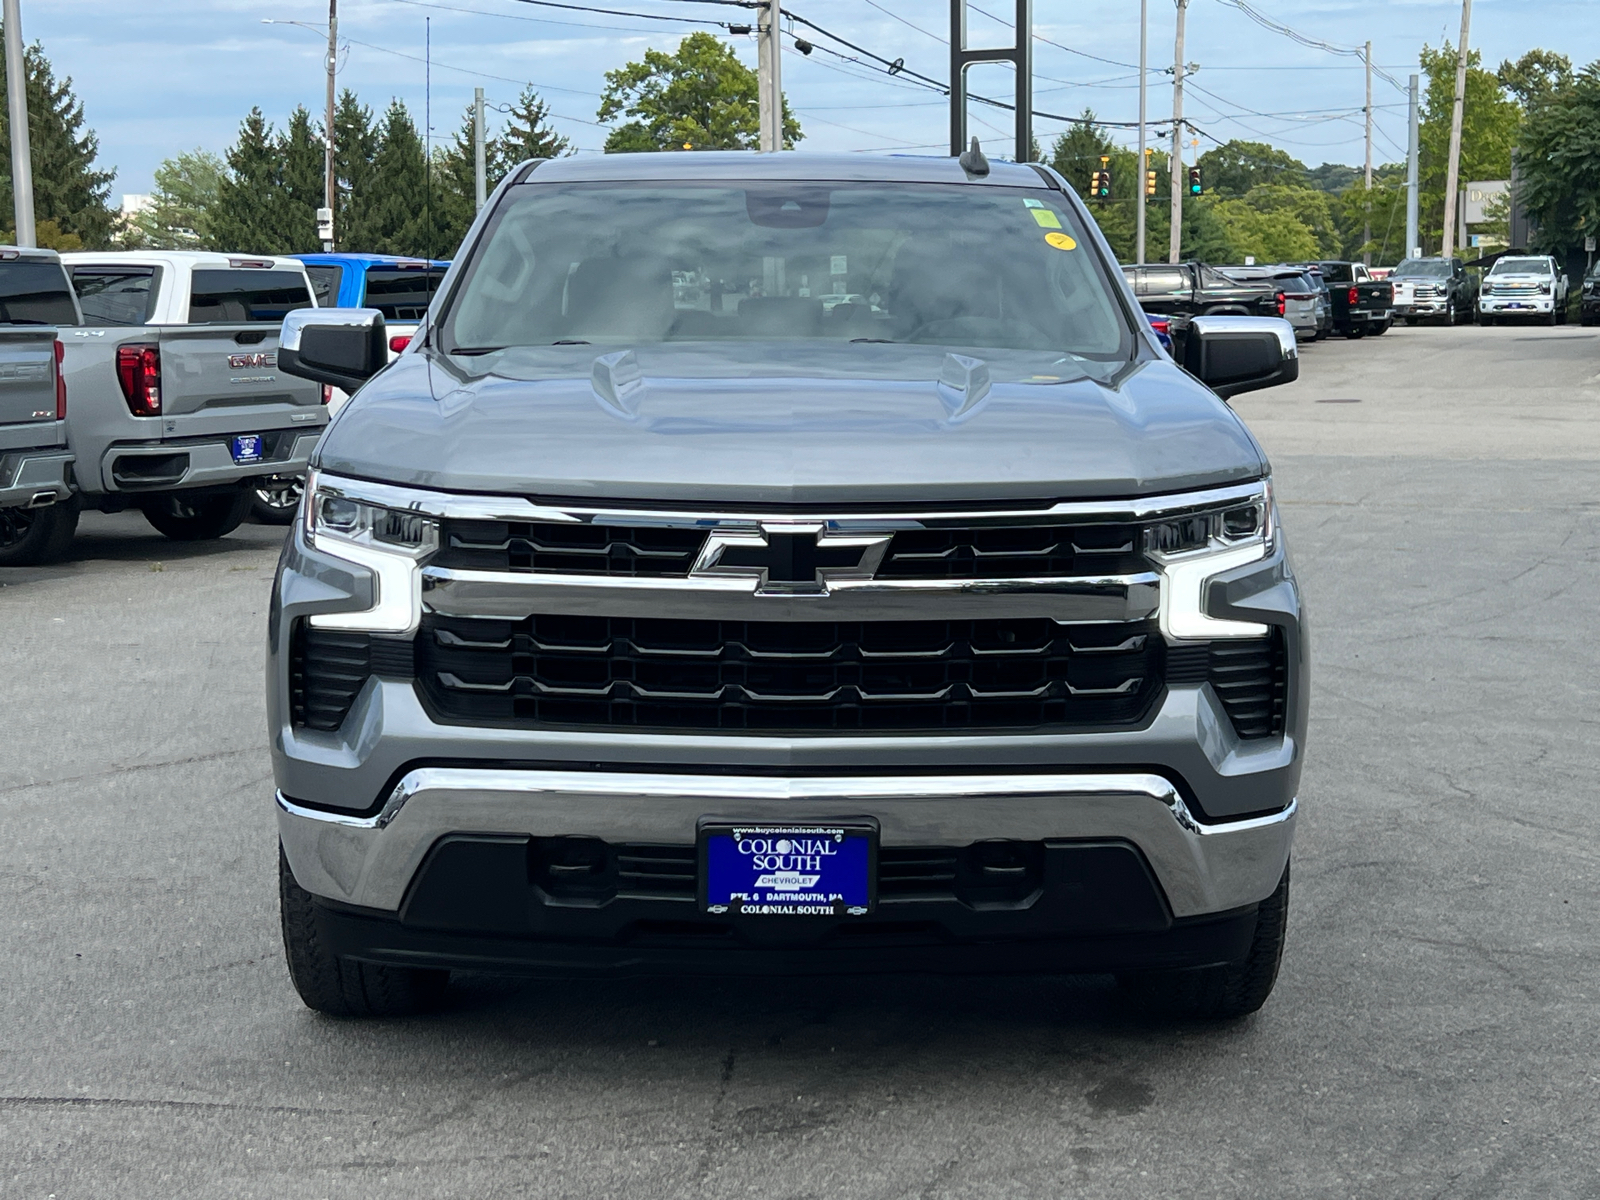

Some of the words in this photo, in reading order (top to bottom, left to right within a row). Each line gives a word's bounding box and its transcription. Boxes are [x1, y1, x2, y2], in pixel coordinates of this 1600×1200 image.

[228, 353, 278, 369] GMC
[738, 838, 837, 855] COLONIAL
[753, 855, 821, 870] SOUTH
[761, 877, 813, 885] CHEVROLET
[753, 893, 760, 901] 6
[766, 893, 827, 903] DARTMOUTH,
[740, 905, 796, 914] COLONIAL
[797, 906, 834, 915] SOUTH
